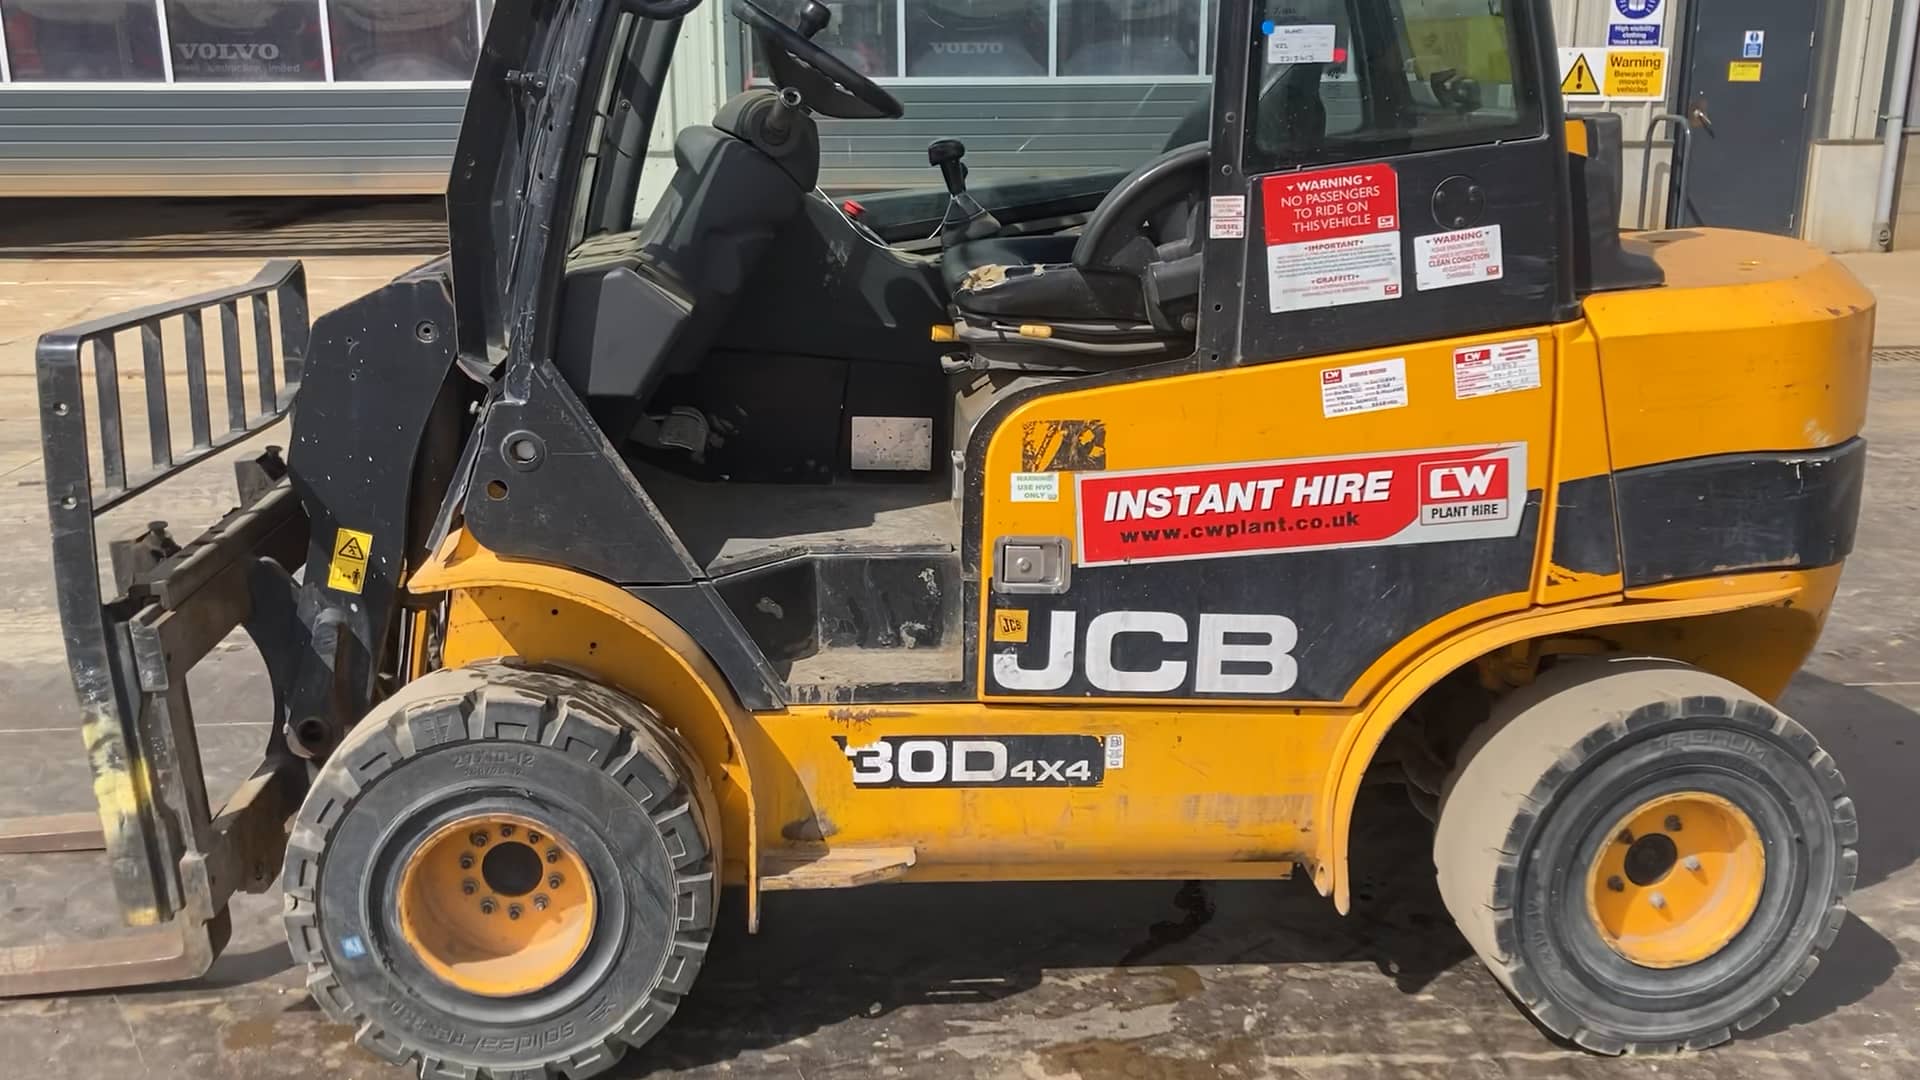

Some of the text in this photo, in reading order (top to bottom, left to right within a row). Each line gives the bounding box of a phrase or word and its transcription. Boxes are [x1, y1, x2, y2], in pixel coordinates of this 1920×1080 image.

[176, 43, 280, 60] VOLVO
[928, 42, 1004, 54] VOLVO
[1610, 55, 1661, 70] Warning
[1614, 70, 1644, 78] Beware
[1618, 79, 1649, 87] moving
[1297, 175, 1363, 192] WARNING
[1281, 186, 1380, 208] NO PASSENGERS
[1294, 201, 1369, 220] TO RIDE ON
[1293, 214, 1371, 233] THIS VEHICLE
[1307, 240, 1360, 252] IMPORTANT
[1432, 230, 1482, 245] WARNING
[1428, 258, 1451, 268] CLEAN
[1452, 253, 1490, 265] CONDITION
[1316, 274, 1356, 285] GRAFFITI
[1464, 351, 1481, 361] CW
[1429, 463, 1497, 500] CW
[1103, 470, 1395, 522] INSTANT HIRE
[1431, 503, 1499, 520] PLANT HIRE
[1119, 510, 1361, 544] www.cwplant.co.uk
[1001, 616, 1023, 634] JCB
[992, 610, 1299, 694] JCB
[844, 740, 1008, 784] 30D
